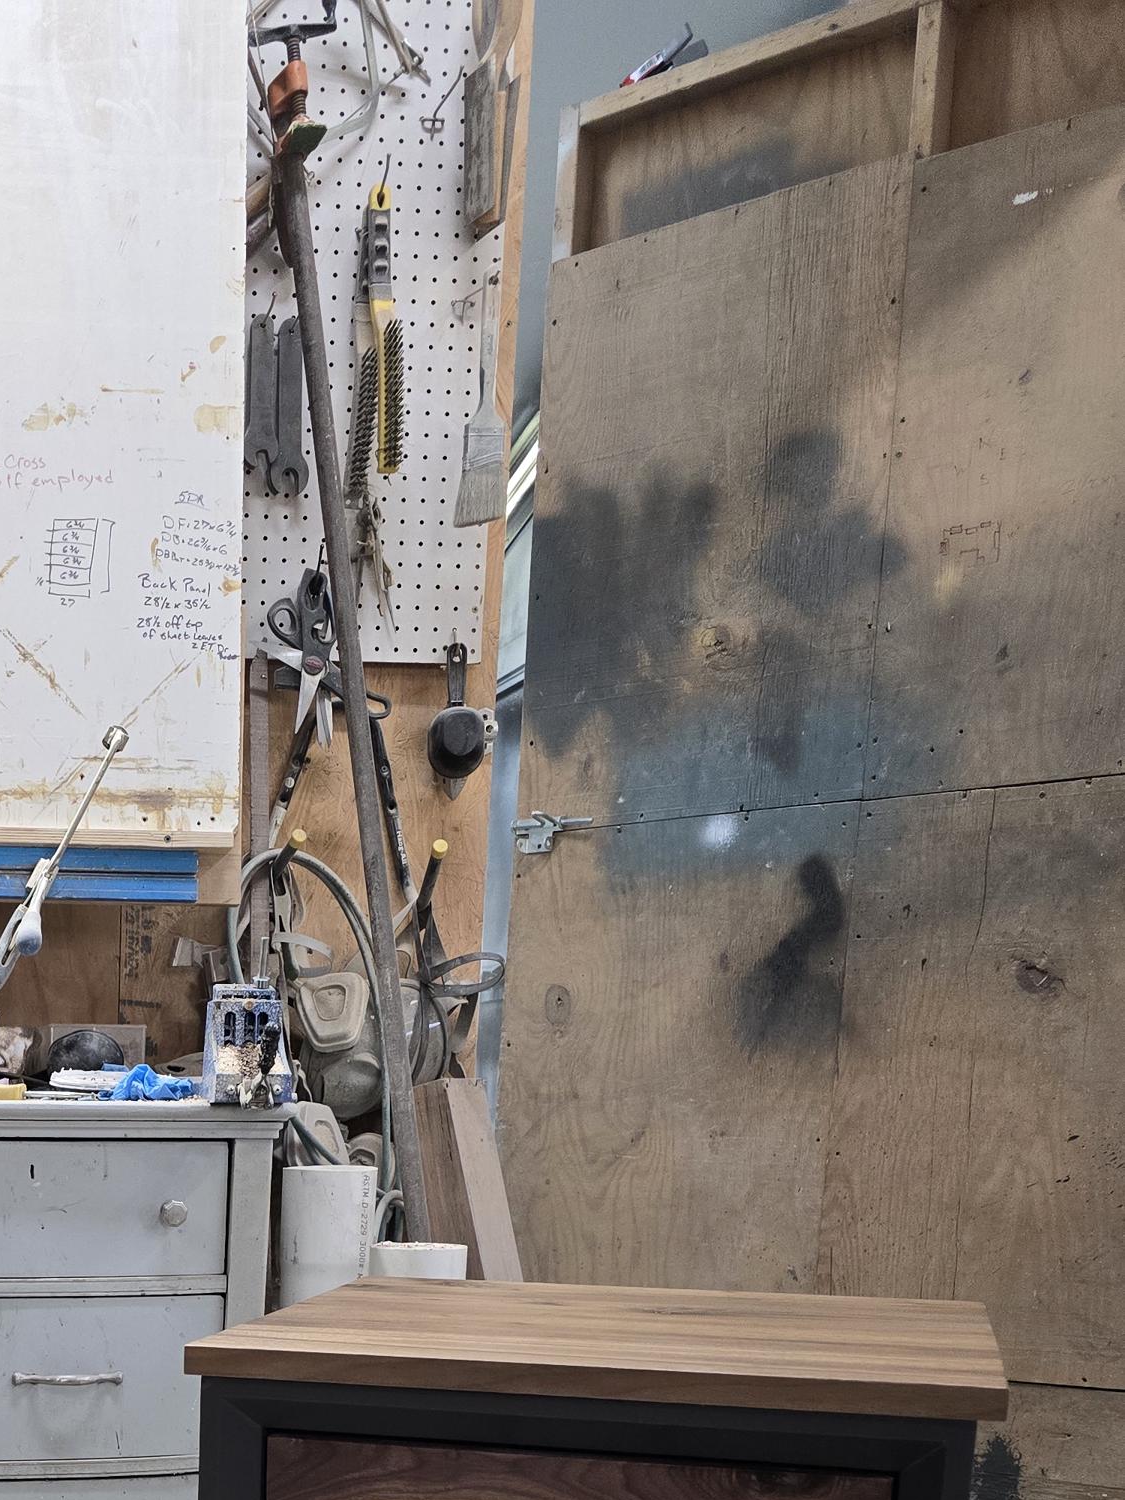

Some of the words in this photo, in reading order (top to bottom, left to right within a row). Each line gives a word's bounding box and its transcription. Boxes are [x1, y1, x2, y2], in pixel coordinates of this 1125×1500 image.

[142, 628, 156, 639] of
[362, 1174, 371, 1198] ASTM
[360, 1202, 369, 1236] D-2729
